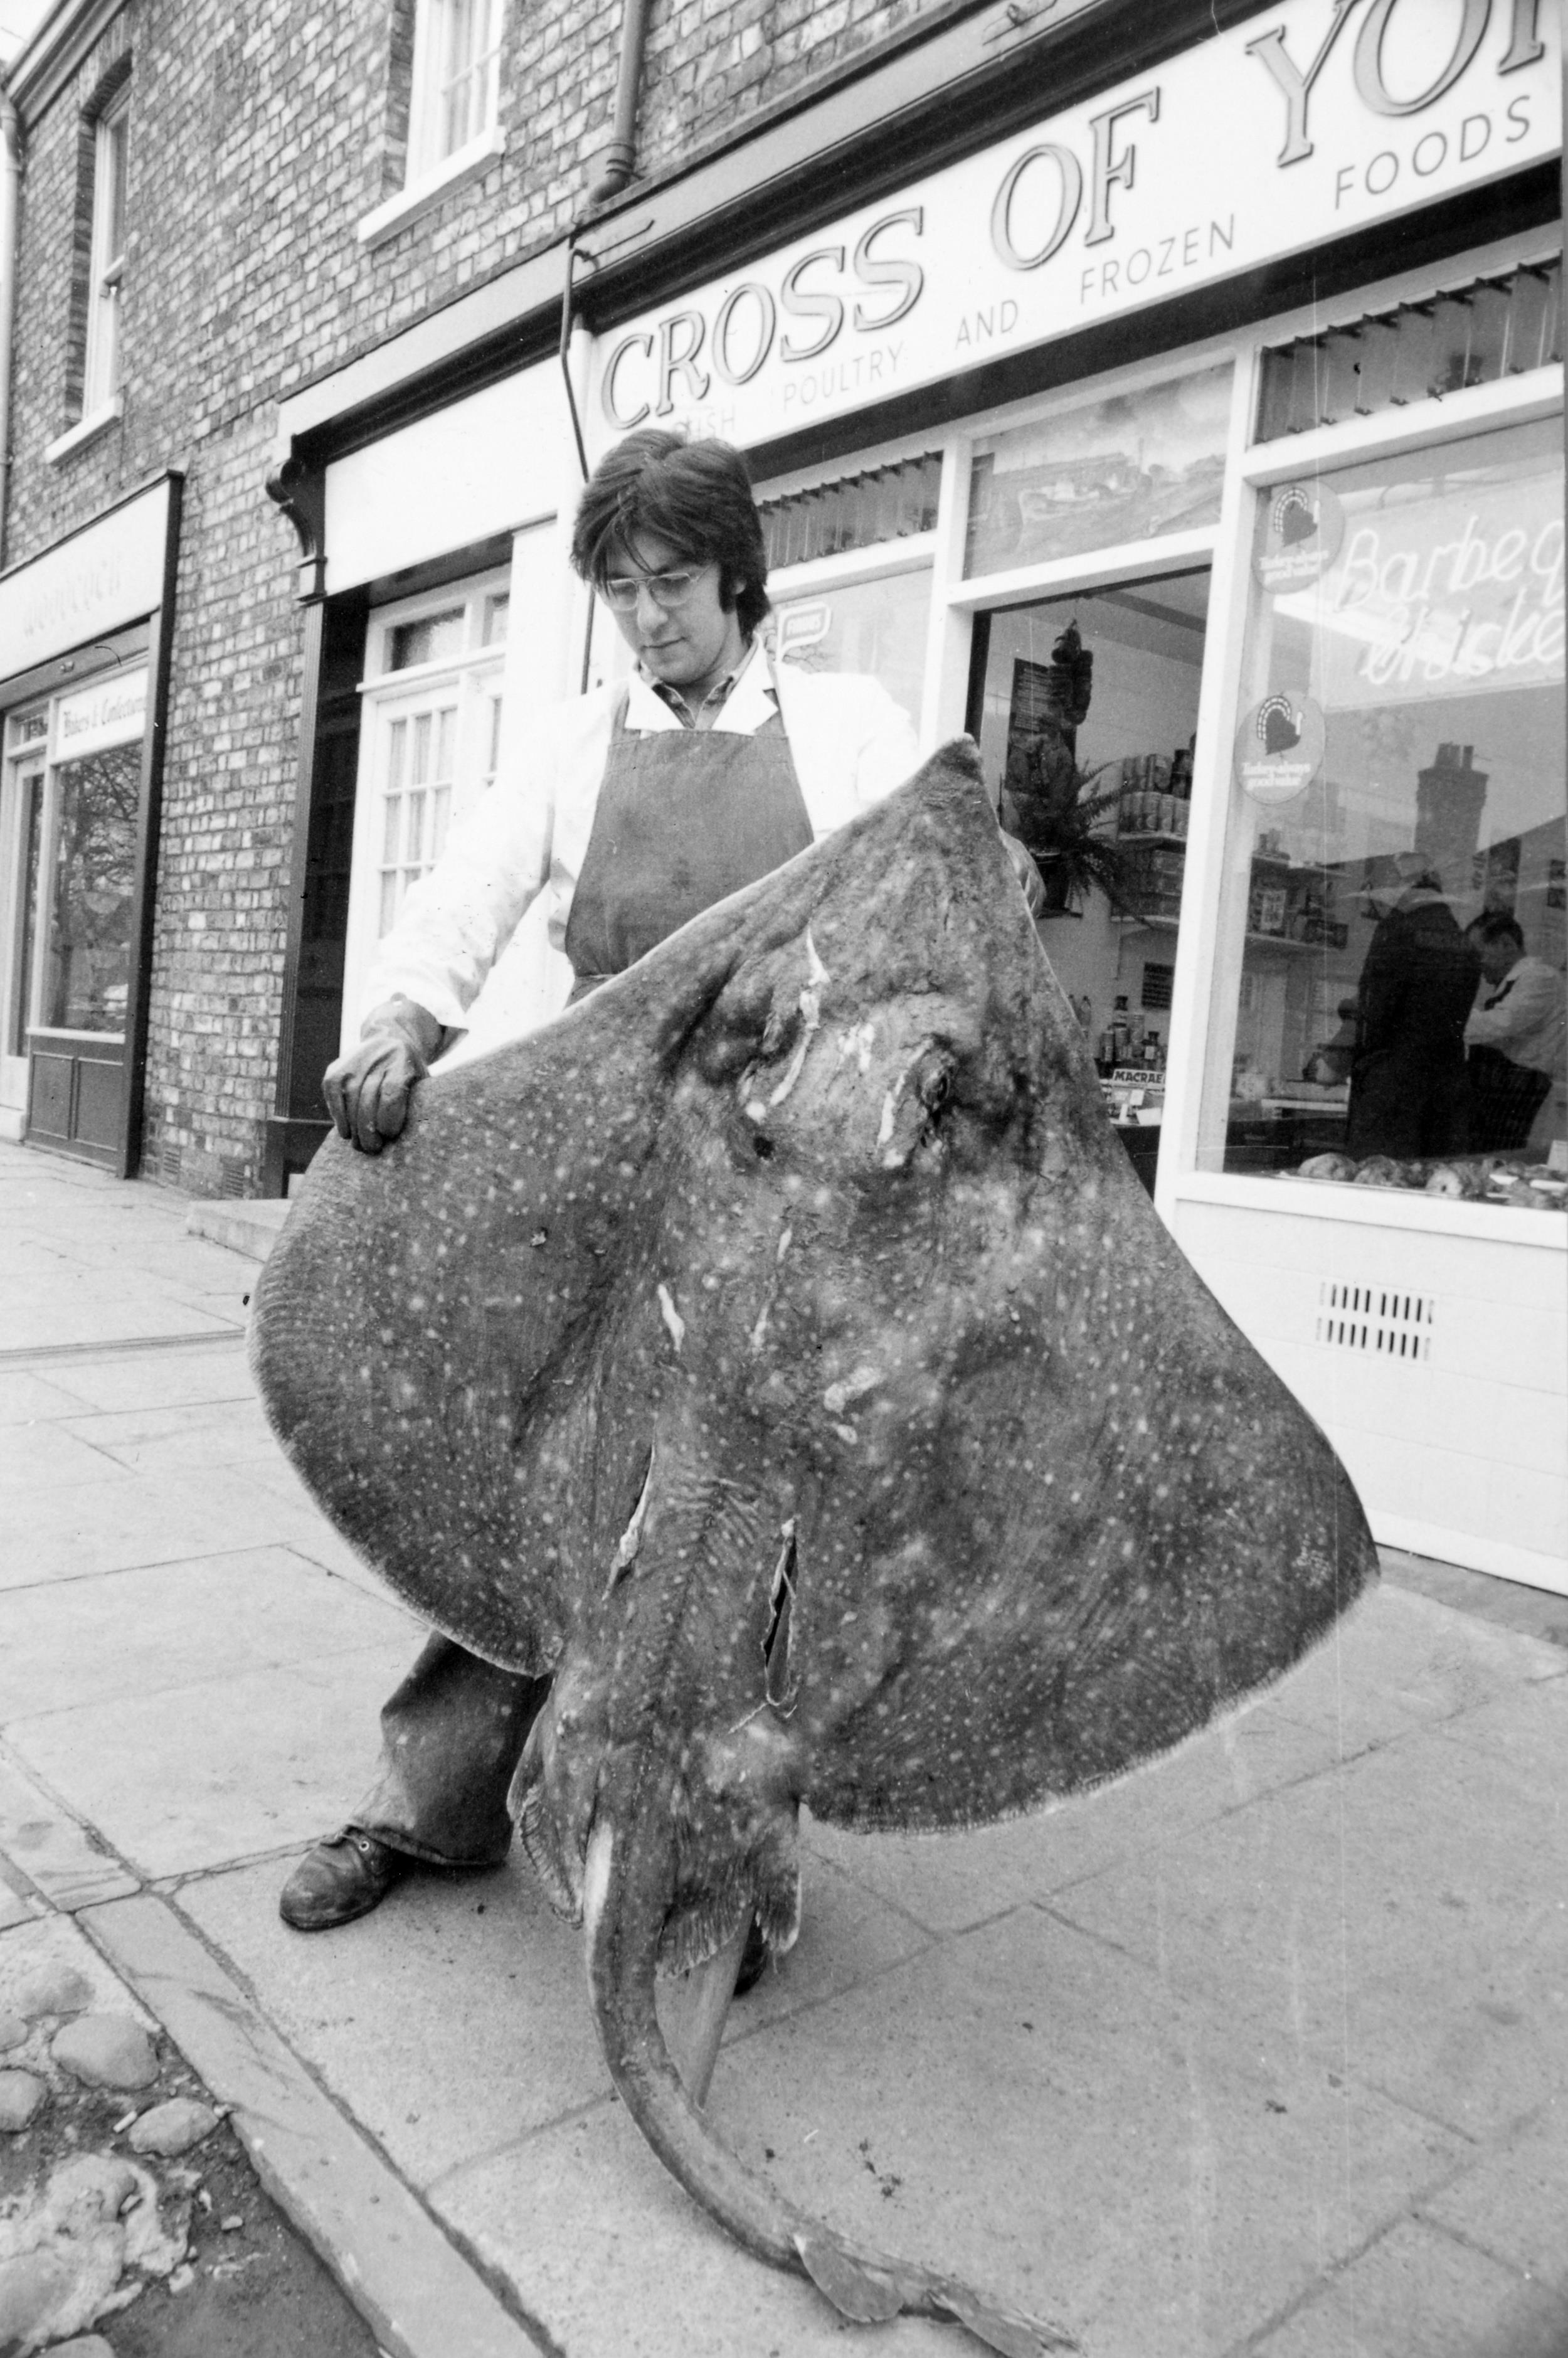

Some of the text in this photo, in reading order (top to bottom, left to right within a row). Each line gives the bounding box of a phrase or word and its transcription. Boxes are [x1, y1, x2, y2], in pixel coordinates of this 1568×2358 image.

[601, 206, 924, 430] CROSS
[990, 85, 1160, 272] OF
[782, 339, 904, 413] POULTRY
[955, 299, 1019, 351] AND
[1079, 213, 1234, 305] FROZEN
[1334, 95, 1530, 210] FOODS
[1115, 1070, 1165, 1085] MACRAE
